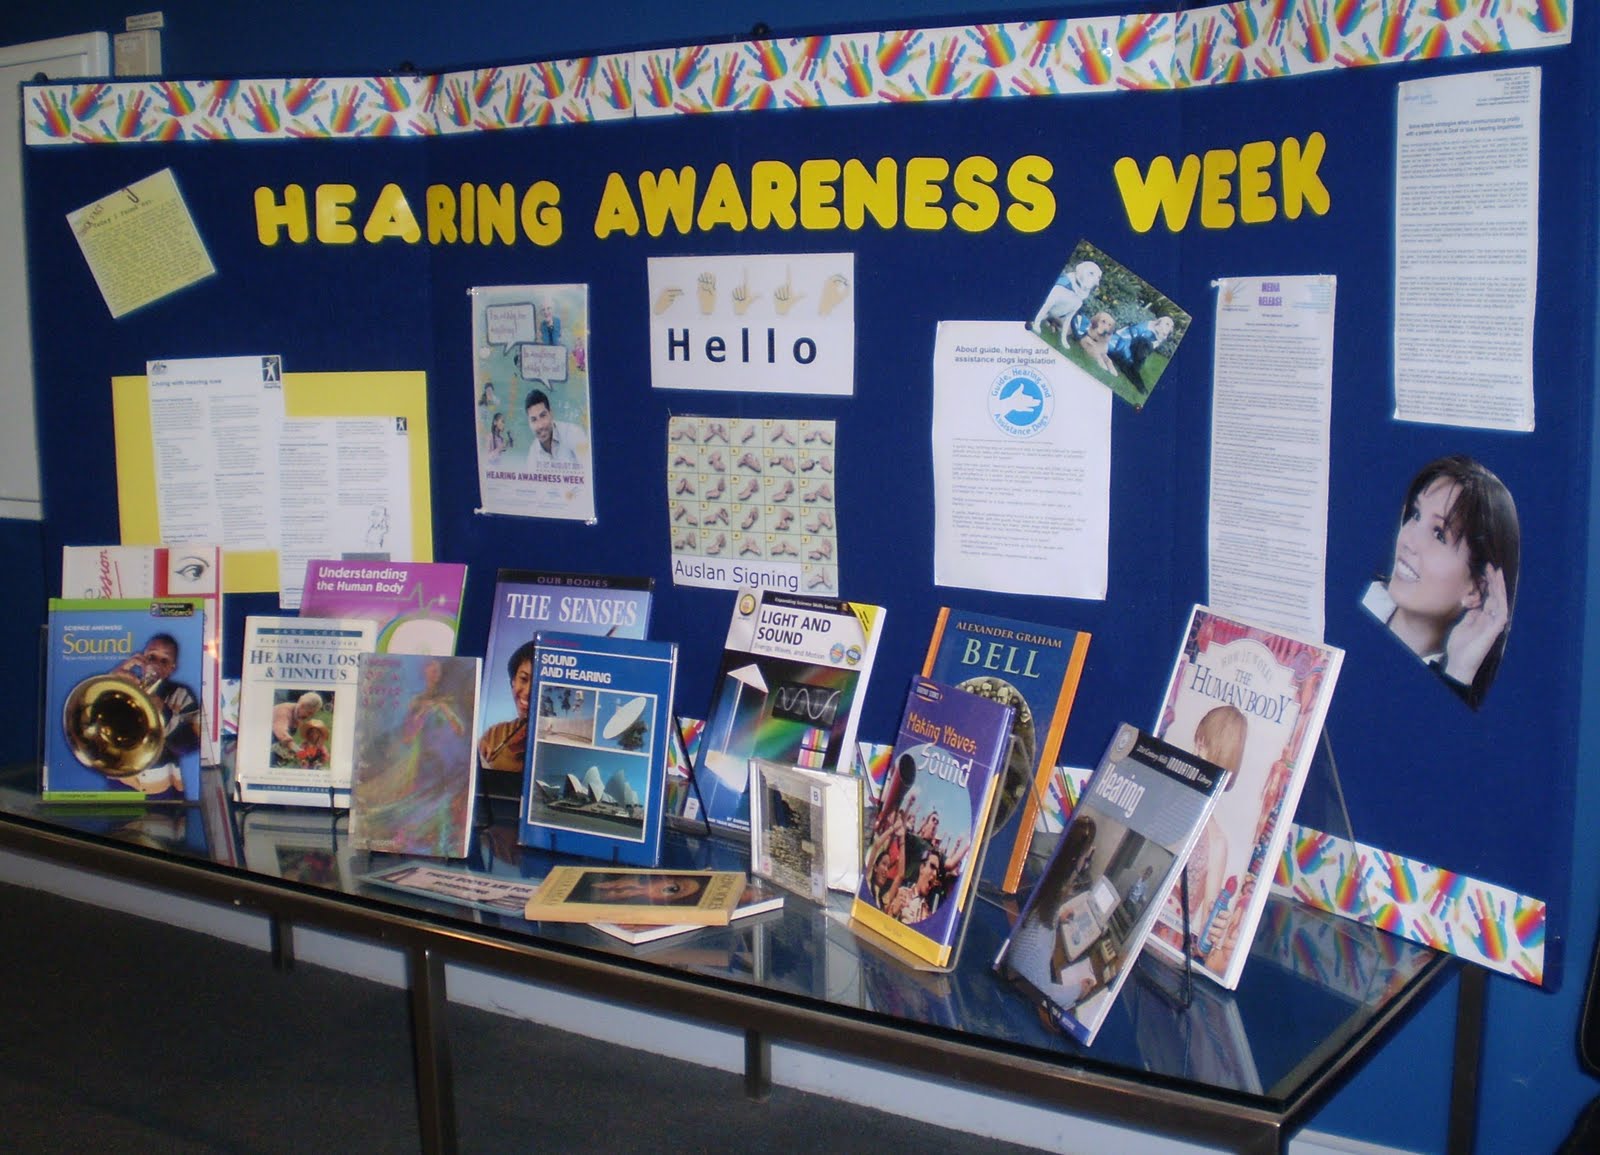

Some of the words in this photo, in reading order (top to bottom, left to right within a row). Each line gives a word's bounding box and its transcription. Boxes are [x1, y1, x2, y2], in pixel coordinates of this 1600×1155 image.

[254, 180, 562, 246] HEARING
[594, 154, 1057, 238] AWARENESS
[1114, 131, 1331, 232] WEEK
[1258, 296, 1282, 306] RELEASE
[667, 327, 817, 364] Hello
[955, 345, 978, 353] About
[1004, 346, 1033, 356] hearing
[997, 356, 1016, 365] dogs
[1017, 357, 1057, 366] legislation
[1012, 367, 1042, 384] Hearing
[1040, 382, 1051, 398] and
[993, 412, 1032, 436] Assistance
[1032, 415, 1049, 432] Dogs
[486, 471, 516, 480] HEARING
[518, 473, 561, 483] AWARENESS
[563, 475, 584, 484] WEEK
[318, 567, 408, 582] Understanding
[537, 576, 561, 585] OUR
[566, 578, 609, 587] BODIES
[674, 560, 726, 581] Auslan
[732, 566, 798, 592] Signing
[317, 581, 334, 590] the
[337, 581, 373, 592] Human
[376, 582, 404, 594] Body
[507, 593, 551, 621] THE
[559, 596, 638, 627] SENSES
[761, 609, 798, 628] LIGHT
[801, 616, 831, 633] AND
[63, 632, 132, 655] Sound
[757, 627, 803, 646] SOUND
[956, 621, 1014, 640] ALEXANDER
[1016, 631, 1062, 648] GRAHAM
[250, 650, 321, 666] HEARING
[328, 653, 361, 667] LOSS
[541, 653, 577, 667] SOUND
[961, 637, 1040, 679] BELL
[265, 667, 274, 678] &
[280, 667, 347, 680] TINNITUS
[540, 667, 563, 678] AND
[565, 669, 611, 684] HEARING
[1235, 669, 1253, 686] THE
[1190, 664, 1248, 707] HUMAN
[1245, 690, 1291, 724] BODY
[906, 712, 941, 746] Making
[943, 725, 977, 755] Waves:
[917, 743, 973, 788] Sound
[1095, 763, 1146, 818] Hearing
